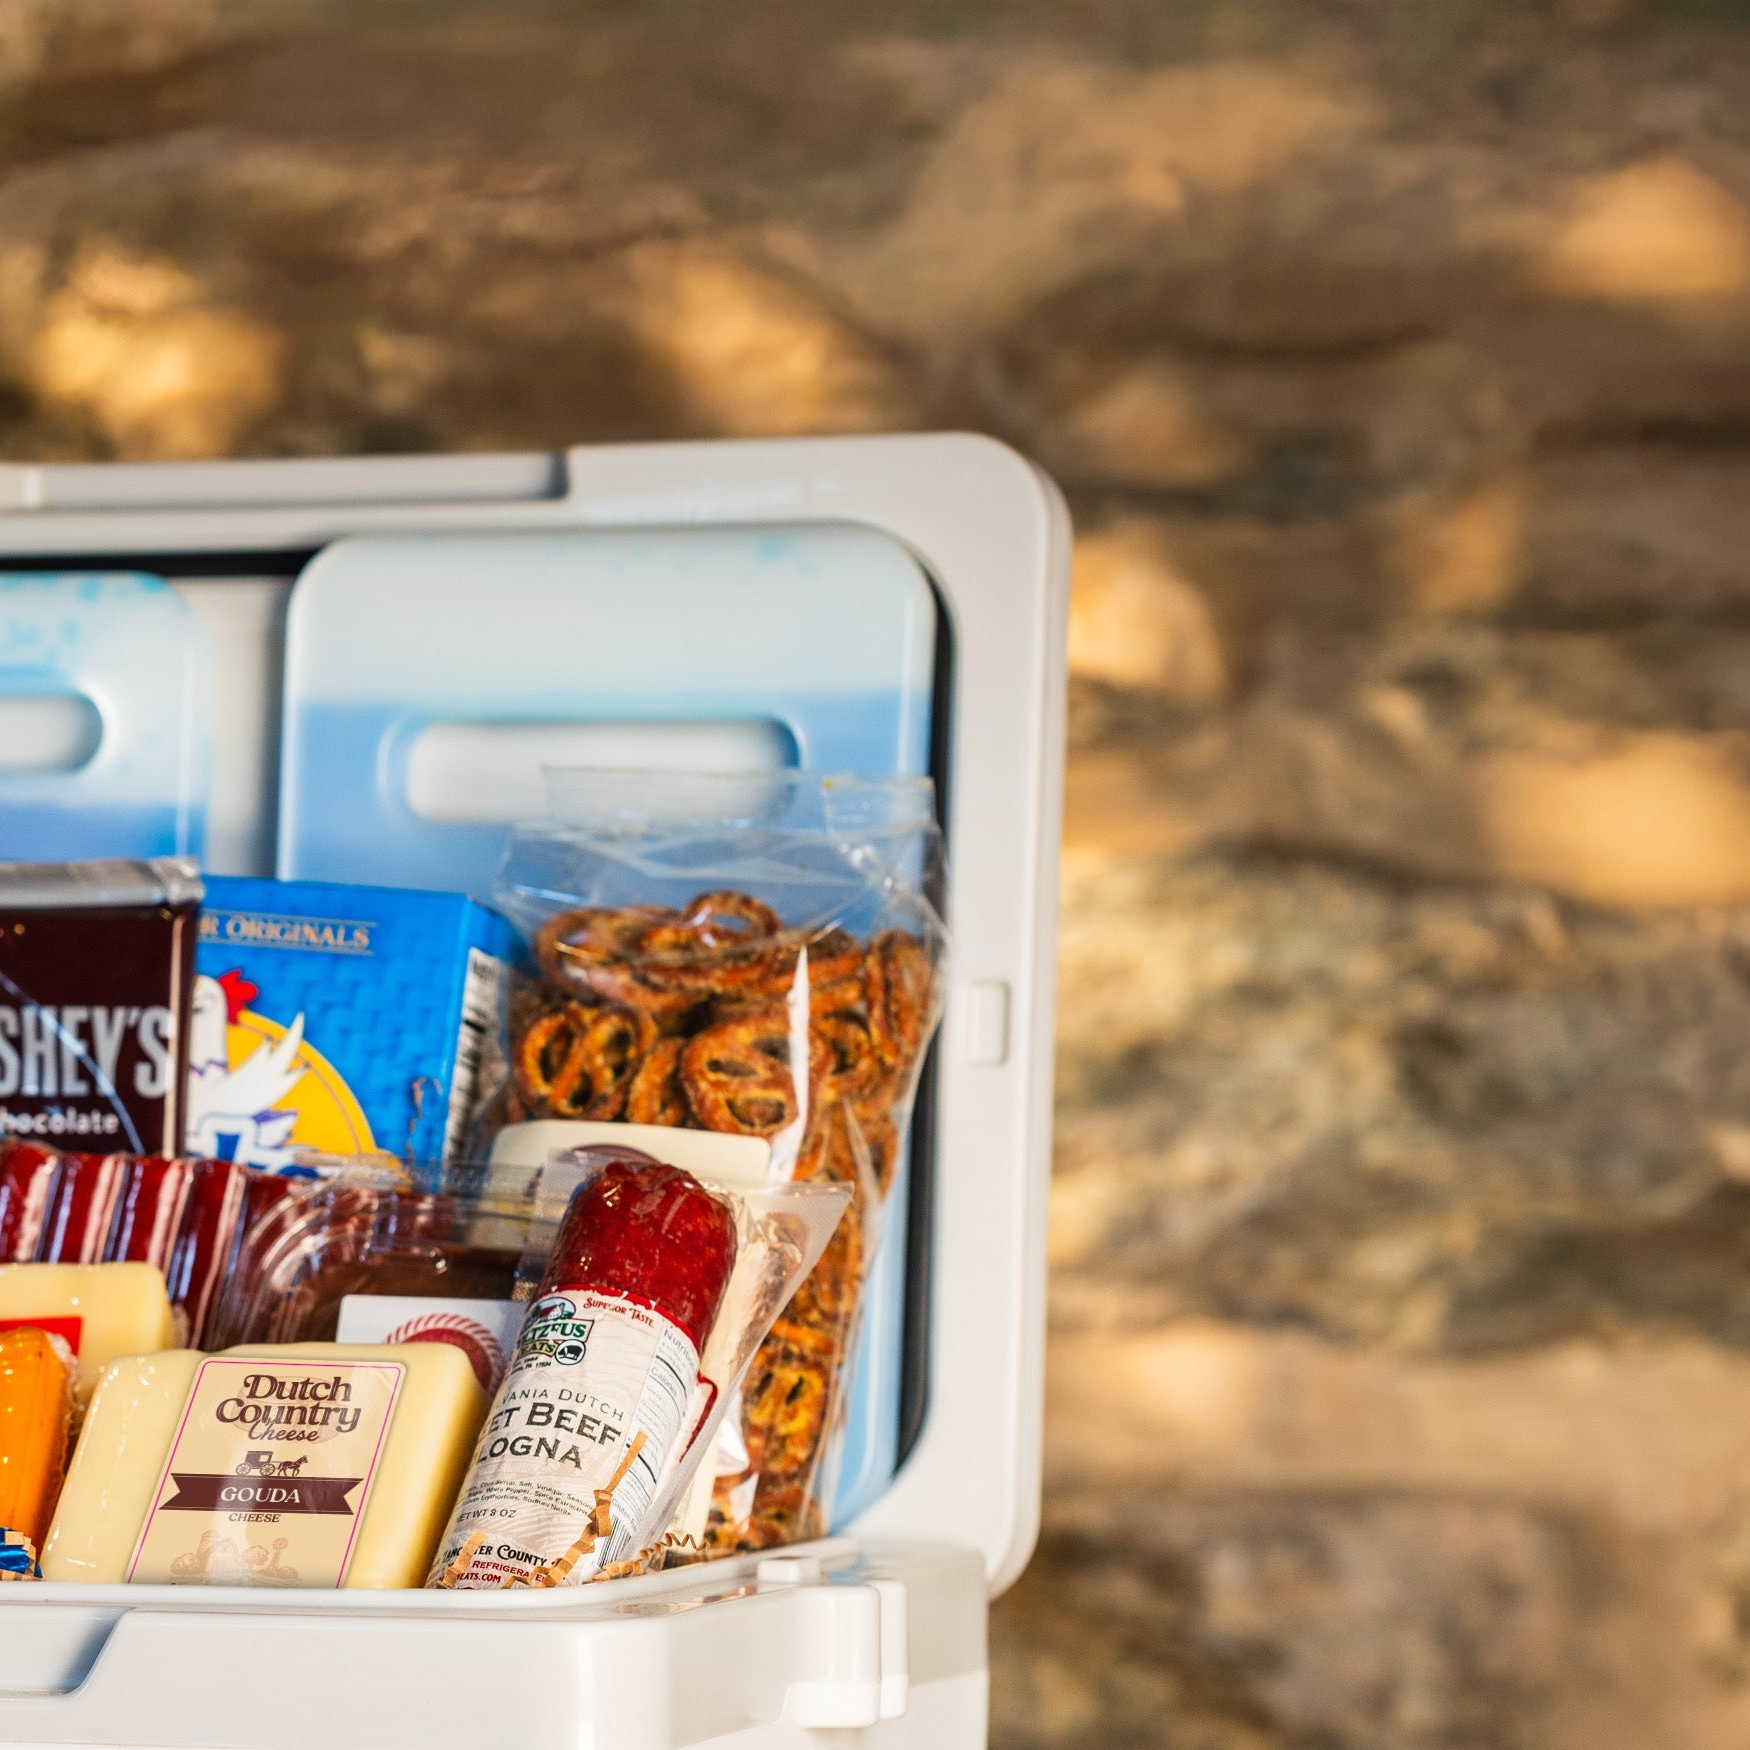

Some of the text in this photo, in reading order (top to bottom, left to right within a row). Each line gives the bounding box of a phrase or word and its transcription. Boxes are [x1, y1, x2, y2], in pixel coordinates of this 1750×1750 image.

[225, 914, 370, 949] ORIGINALS
[242, 1373, 352, 1402] Dutch
[215, 1398, 362, 1433] Country
[558, 1388, 624, 1421] DUTCH
[247, 1418, 320, 1443] Cheese
[525, 1402, 622, 1445] BEEF
[219, 1485, 302, 1504] GOUDA
[228, 1512, 281, 1523] CHEESE
[489, 1508, 497, 1517] 8
[499, 1509, 517, 1518] OZ
[496, 1544, 548, 1567] COUNTY
